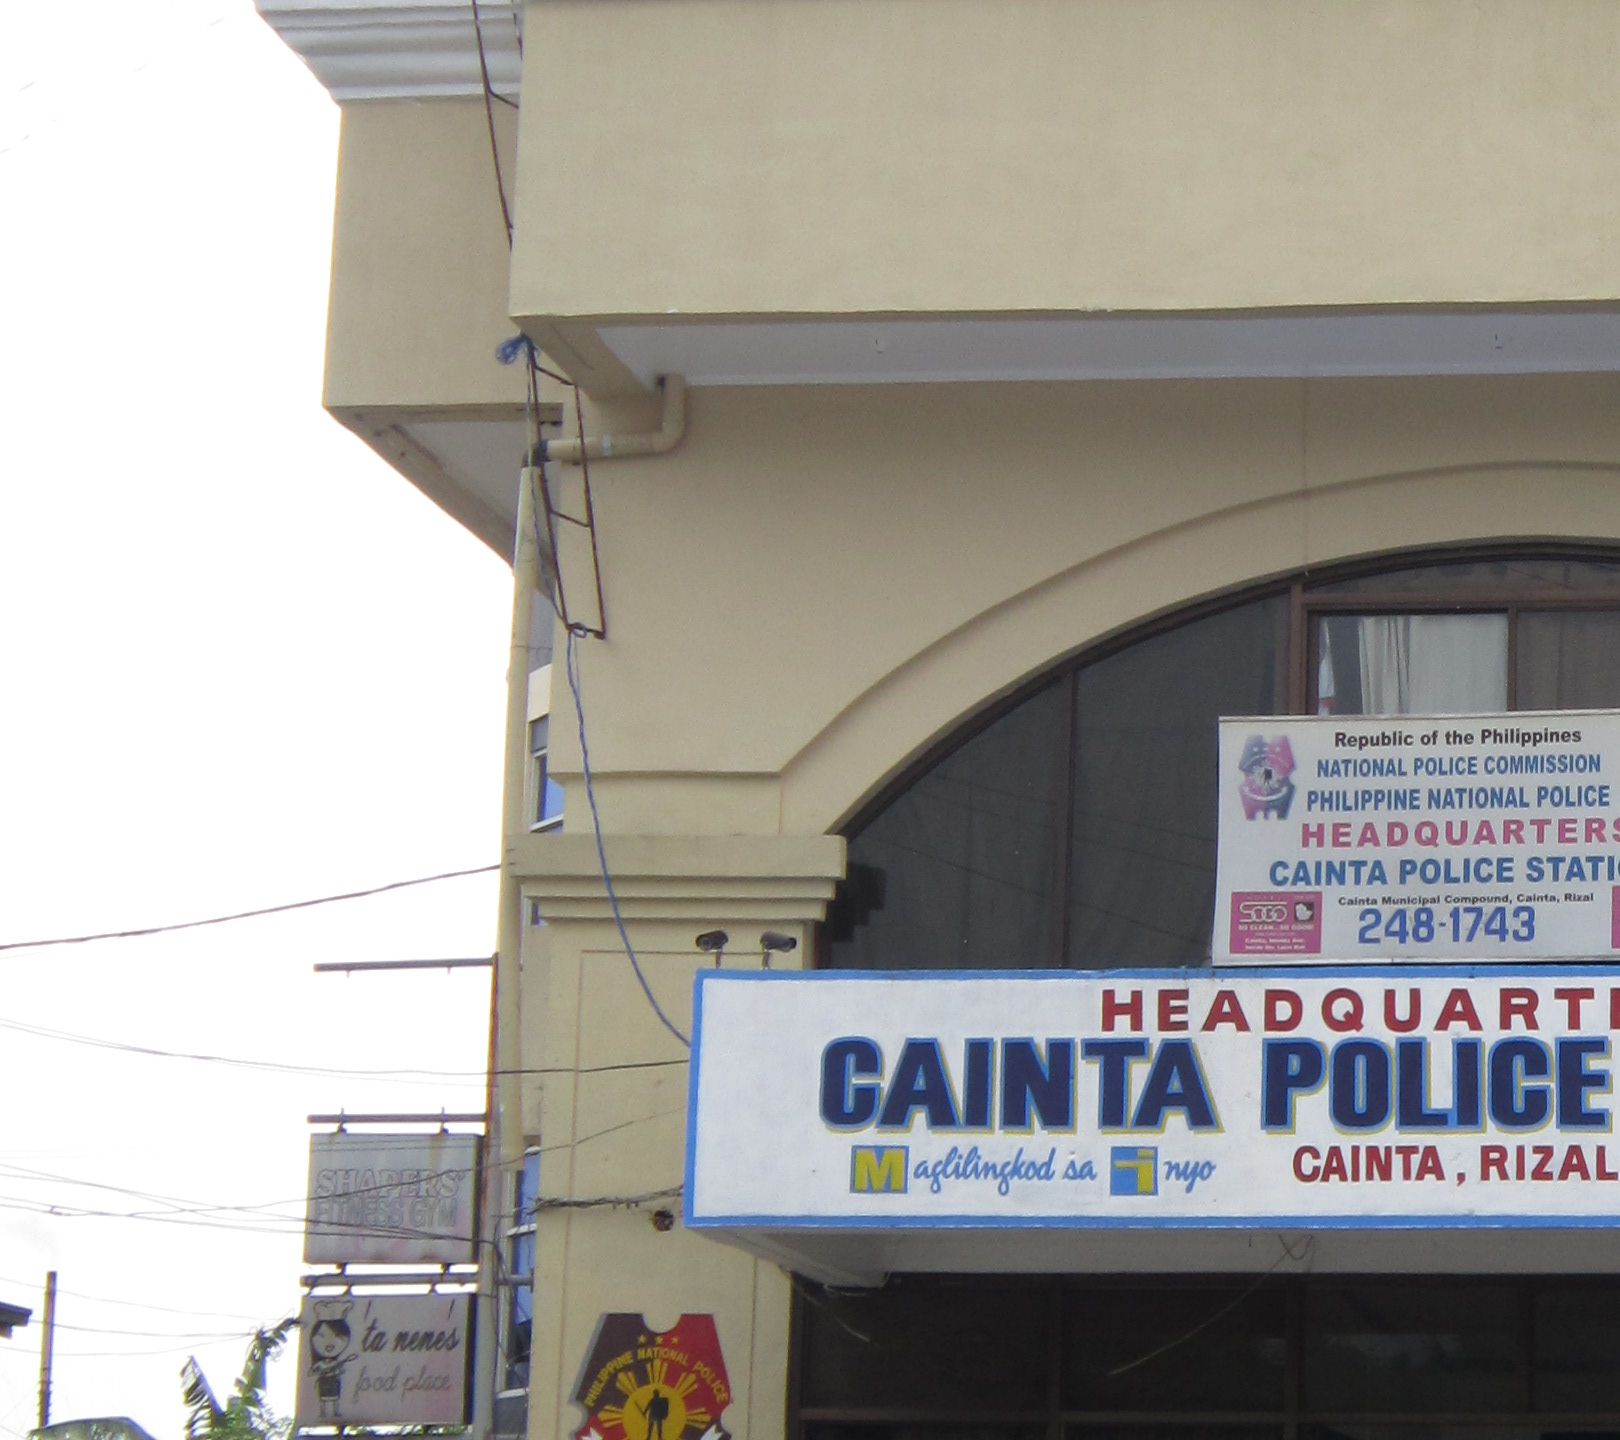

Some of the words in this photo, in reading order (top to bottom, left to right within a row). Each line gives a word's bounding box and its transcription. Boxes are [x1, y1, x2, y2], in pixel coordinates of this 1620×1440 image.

[1335, 730, 1413, 751] Republic
[1419, 729, 1439, 746] of
[1445, 729, 1474, 746] the
[1480, 727, 1582, 749] Philippines
[1317, 757, 1408, 779] NATIONAL
[1413, 756, 1477, 777] POLICE
[1483, 754, 1602, 777] COMMISSION
[1307, 788, 1420, 812] PHILIPPINE
[1427, 787, 1530, 810] NATIONAL
[1536, 785, 1610, 808] POLICE
[1269, 860, 1388, 887] CAINTA
[1400, 856, 1515, 884] POLICE
[1338, 896, 1378, 906] Cainta
[1381, 895, 1440, 907] Municipal
[1444, 894, 1513, 906] Compound,
[1516, 893, 1560, 903] Cainta,
[1564, 892, 1594, 902] Rizal
[1358, 906, 1535, 944] 248-1743
[819, 1036, 1225, 1135] CAINTA
[1261, 1035, 1614, 1135] POLICE
[1062, 1159, 1098, 1183] sa
[1480, 1143, 1618, 1182] RIZAL
[584, 1350, 634, 1408] PHILIPPINE
[637, 1346, 689, 1367] NATIONAL
[692, 1361, 729, 1405] POLICE
